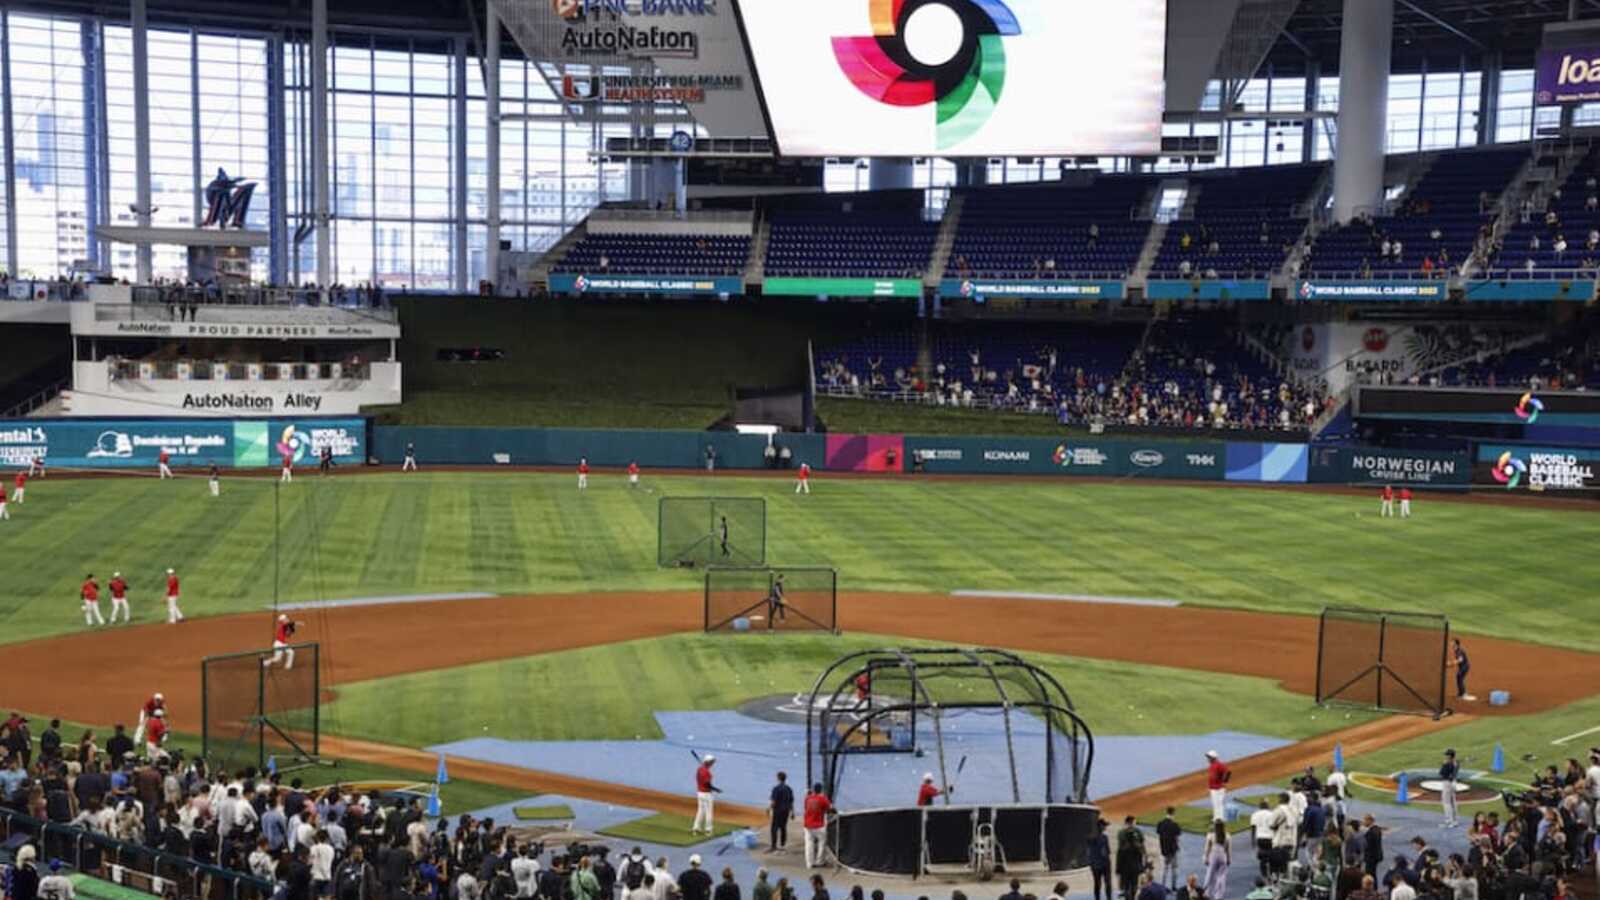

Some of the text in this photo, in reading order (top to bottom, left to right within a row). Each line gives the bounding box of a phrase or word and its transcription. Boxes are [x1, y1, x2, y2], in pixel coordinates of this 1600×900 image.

[562, 27, 694, 48] AutoNation
[605, 76, 674, 87] UNIVERSITY
[698, 76, 742, 89] MIAMI
[188, 325, 239, 335] PROUD
[247, 326, 317, 336] PARTNERS
[182, 392, 322, 411] AutoNation Alley
[983, 451, 1030, 460] KONAMI
[1530, 453, 1577, 466] WORLD
[1352, 456, 1455, 474] NORWEGIAN
[1530, 463, 1594, 478] BASEBALL
[1369, 469, 1432, 482] CRUISE LINE
[1530, 474, 1584, 488] CLASSIC
